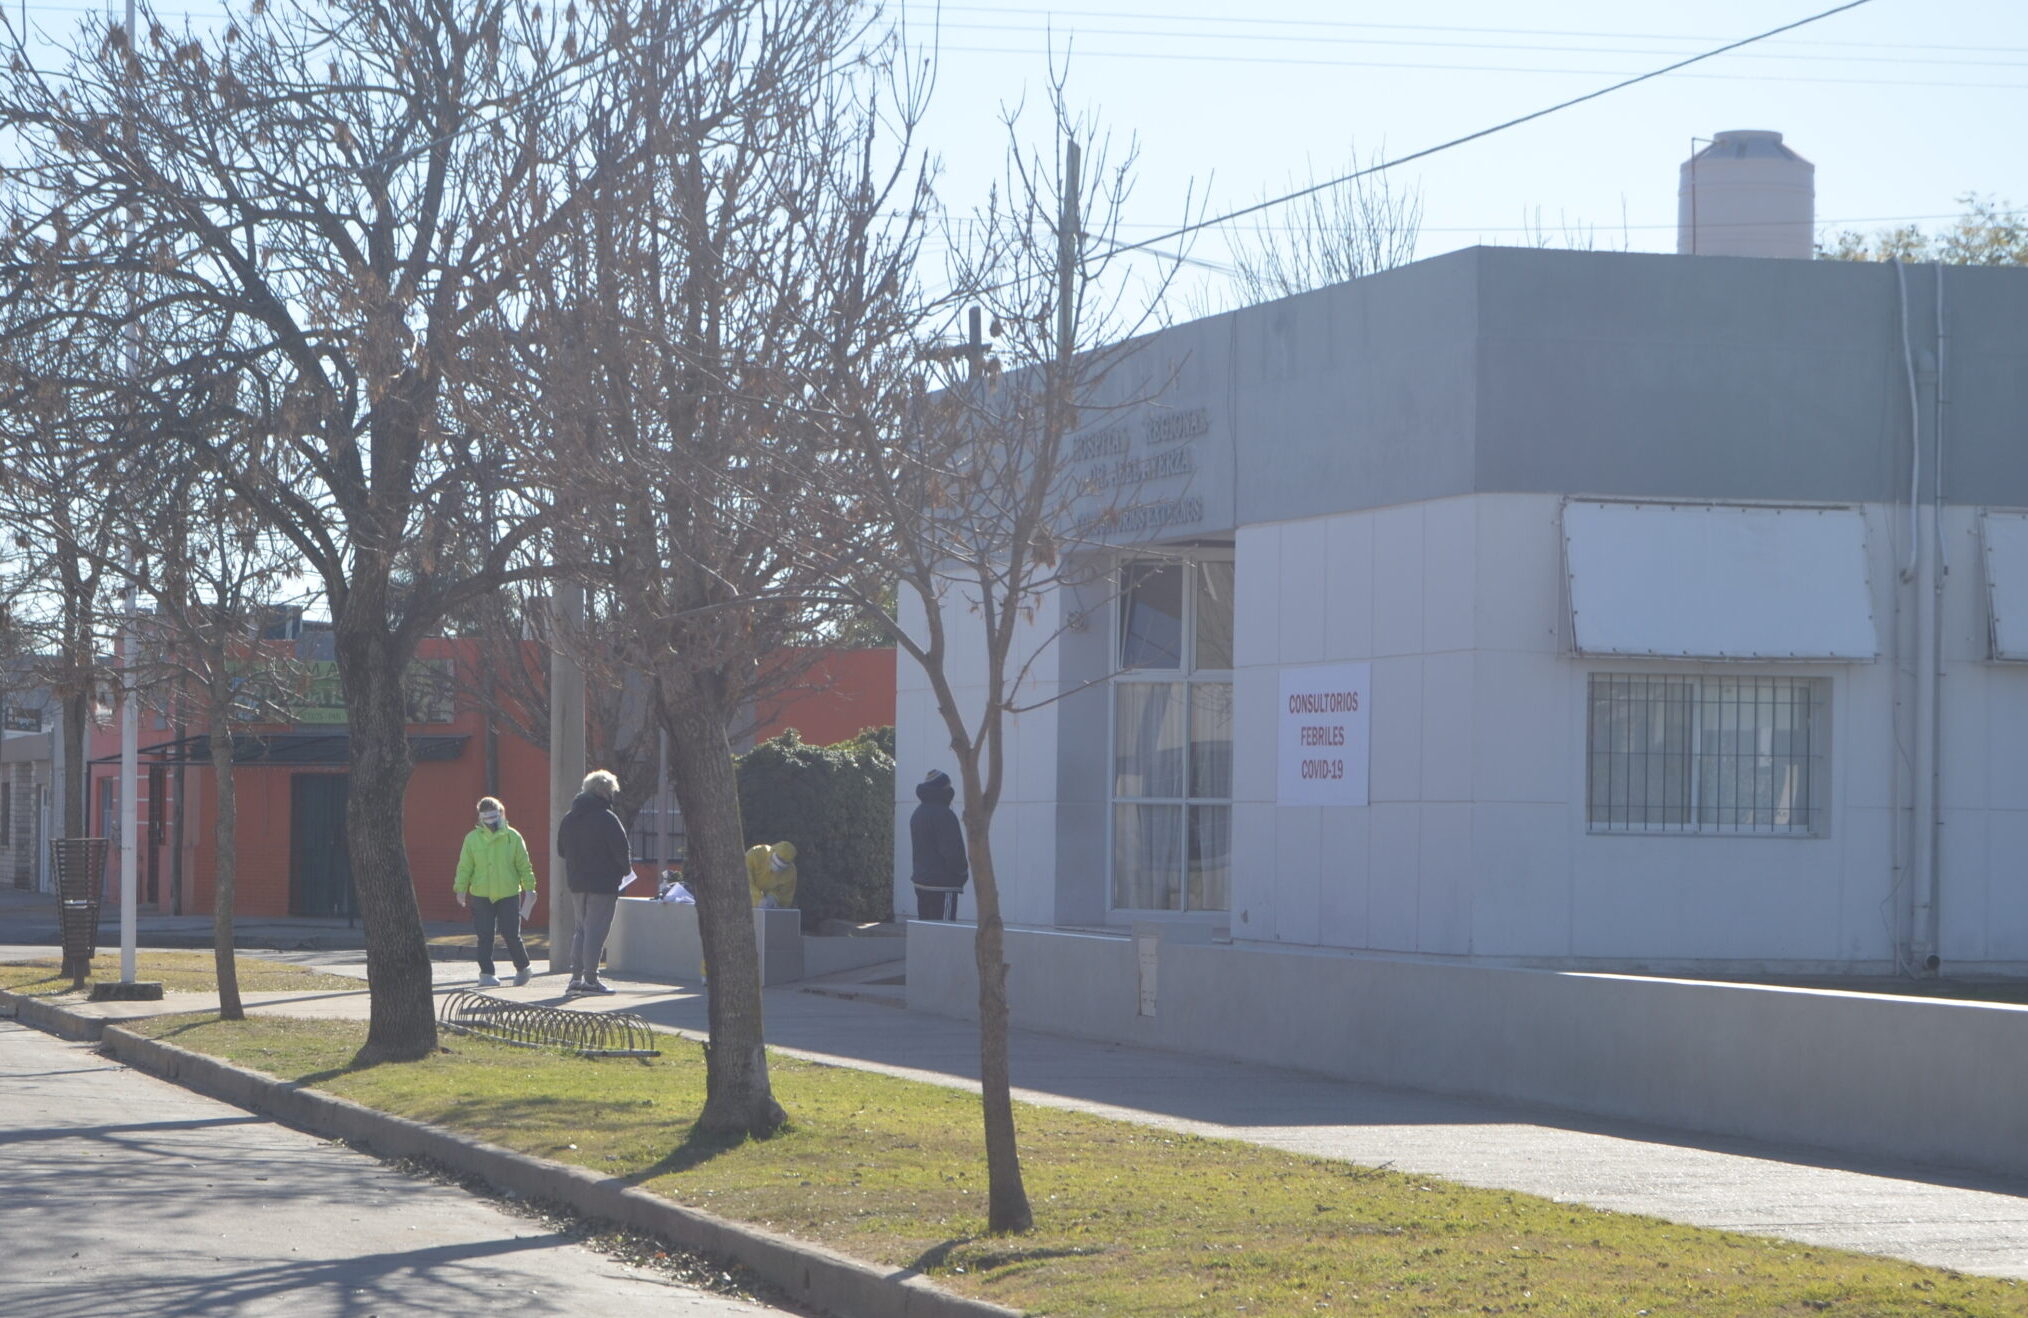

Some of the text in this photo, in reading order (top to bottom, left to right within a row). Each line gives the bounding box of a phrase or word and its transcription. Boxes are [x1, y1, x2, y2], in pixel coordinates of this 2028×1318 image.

[1145, 407, 1209, 446] REGIONAL
[1289, 692, 1358, 714] CONSULTORIOS
[1301, 726, 1345, 746] FEBRILES
[1301, 759, 1343, 779] COVID-19
